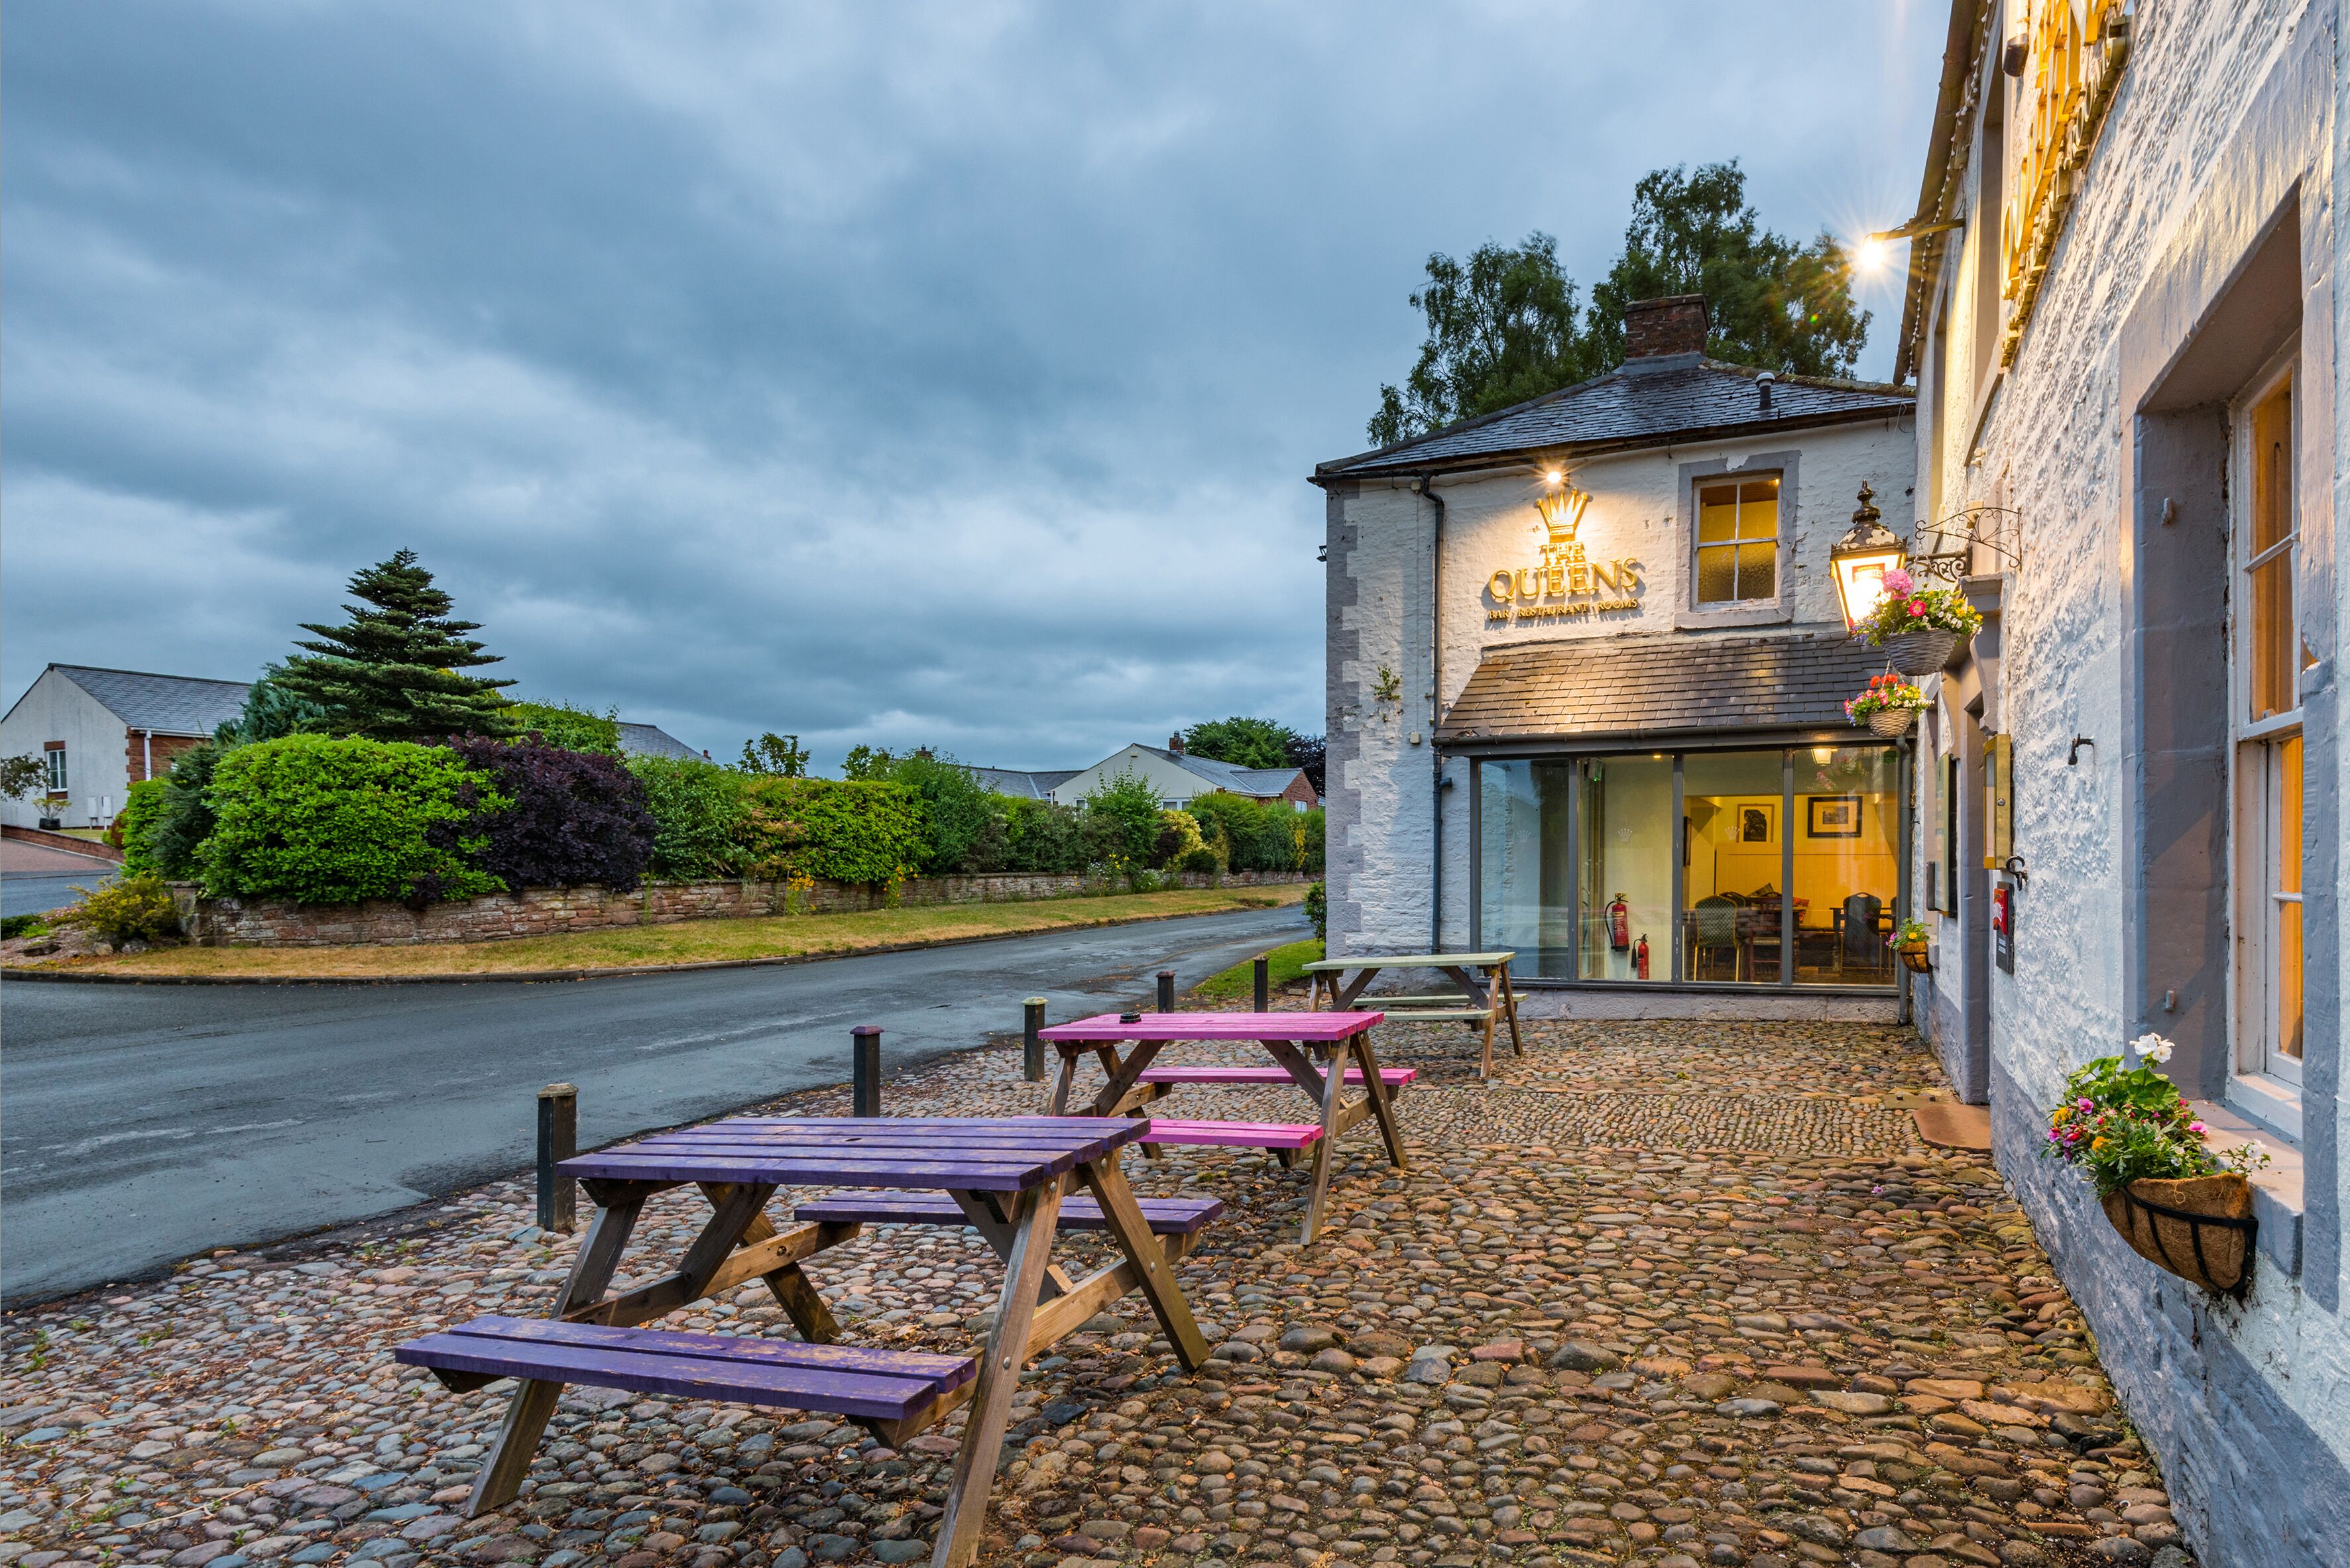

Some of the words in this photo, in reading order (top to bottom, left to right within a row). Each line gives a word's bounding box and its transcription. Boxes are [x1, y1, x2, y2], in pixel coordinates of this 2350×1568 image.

[2000, 0, 2109, 300] QUEEN
[1539, 541, 1584, 559] THE
[1488, 557, 1639, 601] QUEENS
[1489, 610, 1510, 621] BAR
[1517, 602, 1590, 618] RESTAURANT
[1598, 598, 1638, 611] ROOMS
